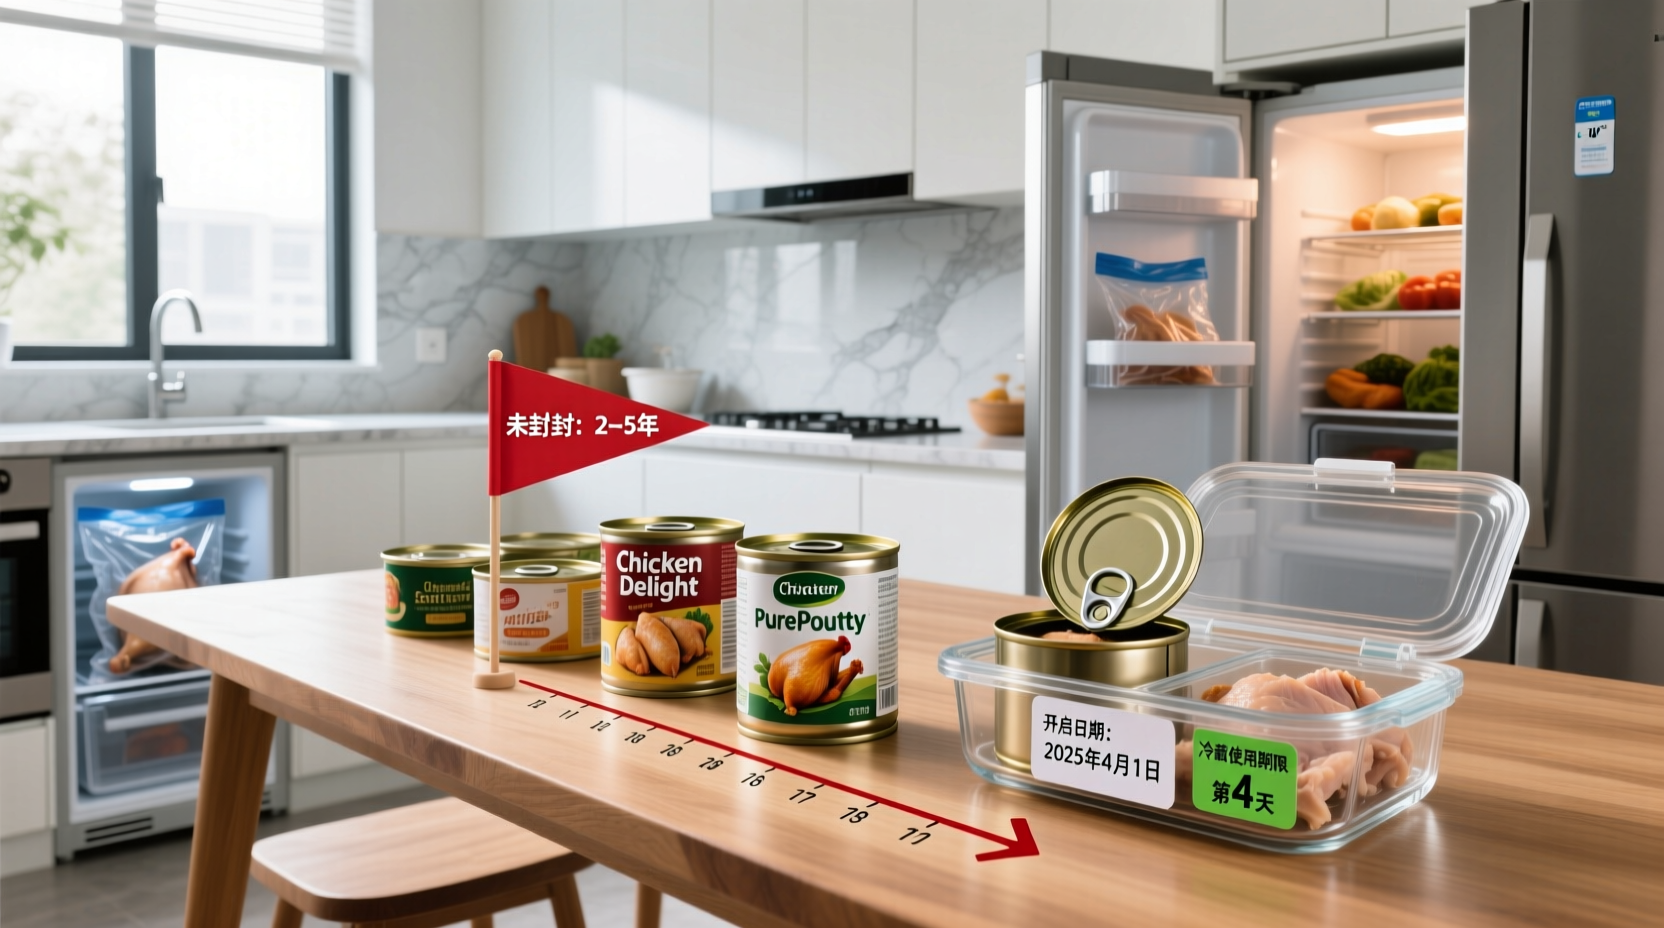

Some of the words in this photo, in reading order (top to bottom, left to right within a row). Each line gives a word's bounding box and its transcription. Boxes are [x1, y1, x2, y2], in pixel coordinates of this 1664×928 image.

[616, 550, 703, 574] Chicken
[619, 575, 699, 603] Delight
[755, 607, 867, 635] PurePoutty
[1043, 741, 1161, 784] 2025年4月1日
[740, 772, 766, 787] 16
[789, 788, 816, 804] 17
[1211, 773, 1275, 815] 第4天
